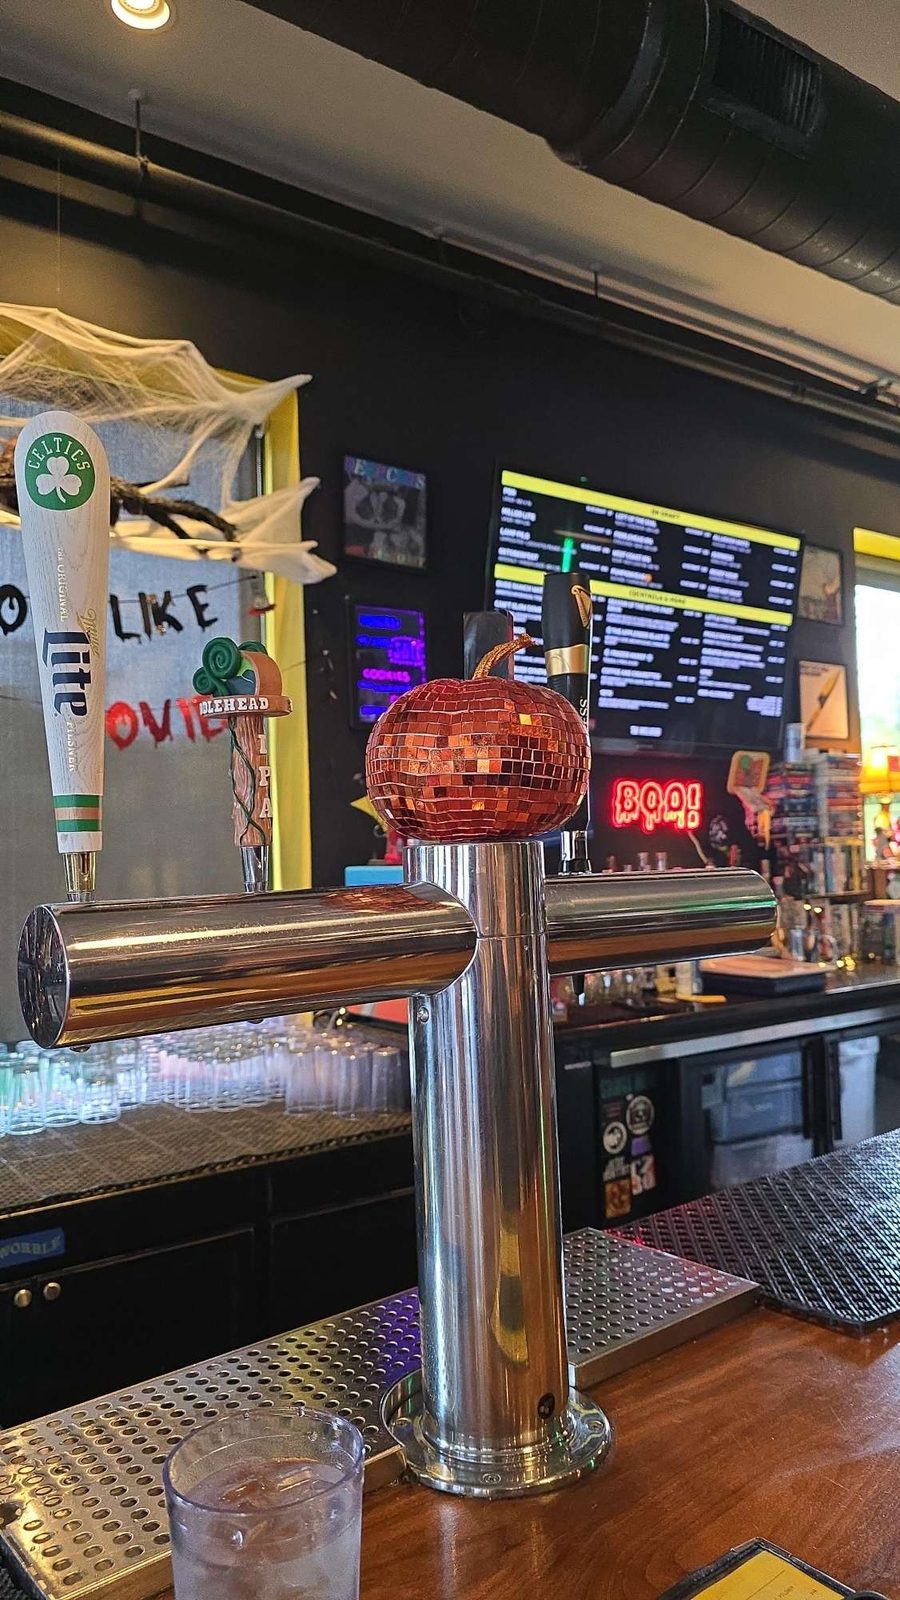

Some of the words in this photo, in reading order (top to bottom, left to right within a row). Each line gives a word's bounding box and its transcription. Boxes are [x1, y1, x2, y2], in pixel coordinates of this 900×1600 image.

[27, 437, 91, 470] CELTICS
[57, 563, 69, 622] ORIGINAL
[109, 584, 218, 644] LIKE
[76, 607, 99, 656] Miller
[42, 628, 92, 716] Lite
[199, 697, 269, 715] DLEHEAD
[66, 721, 75, 772] PILSNER
[258, 734, 273, 818] IPA
[615, 780, 701, 831] BOO!
